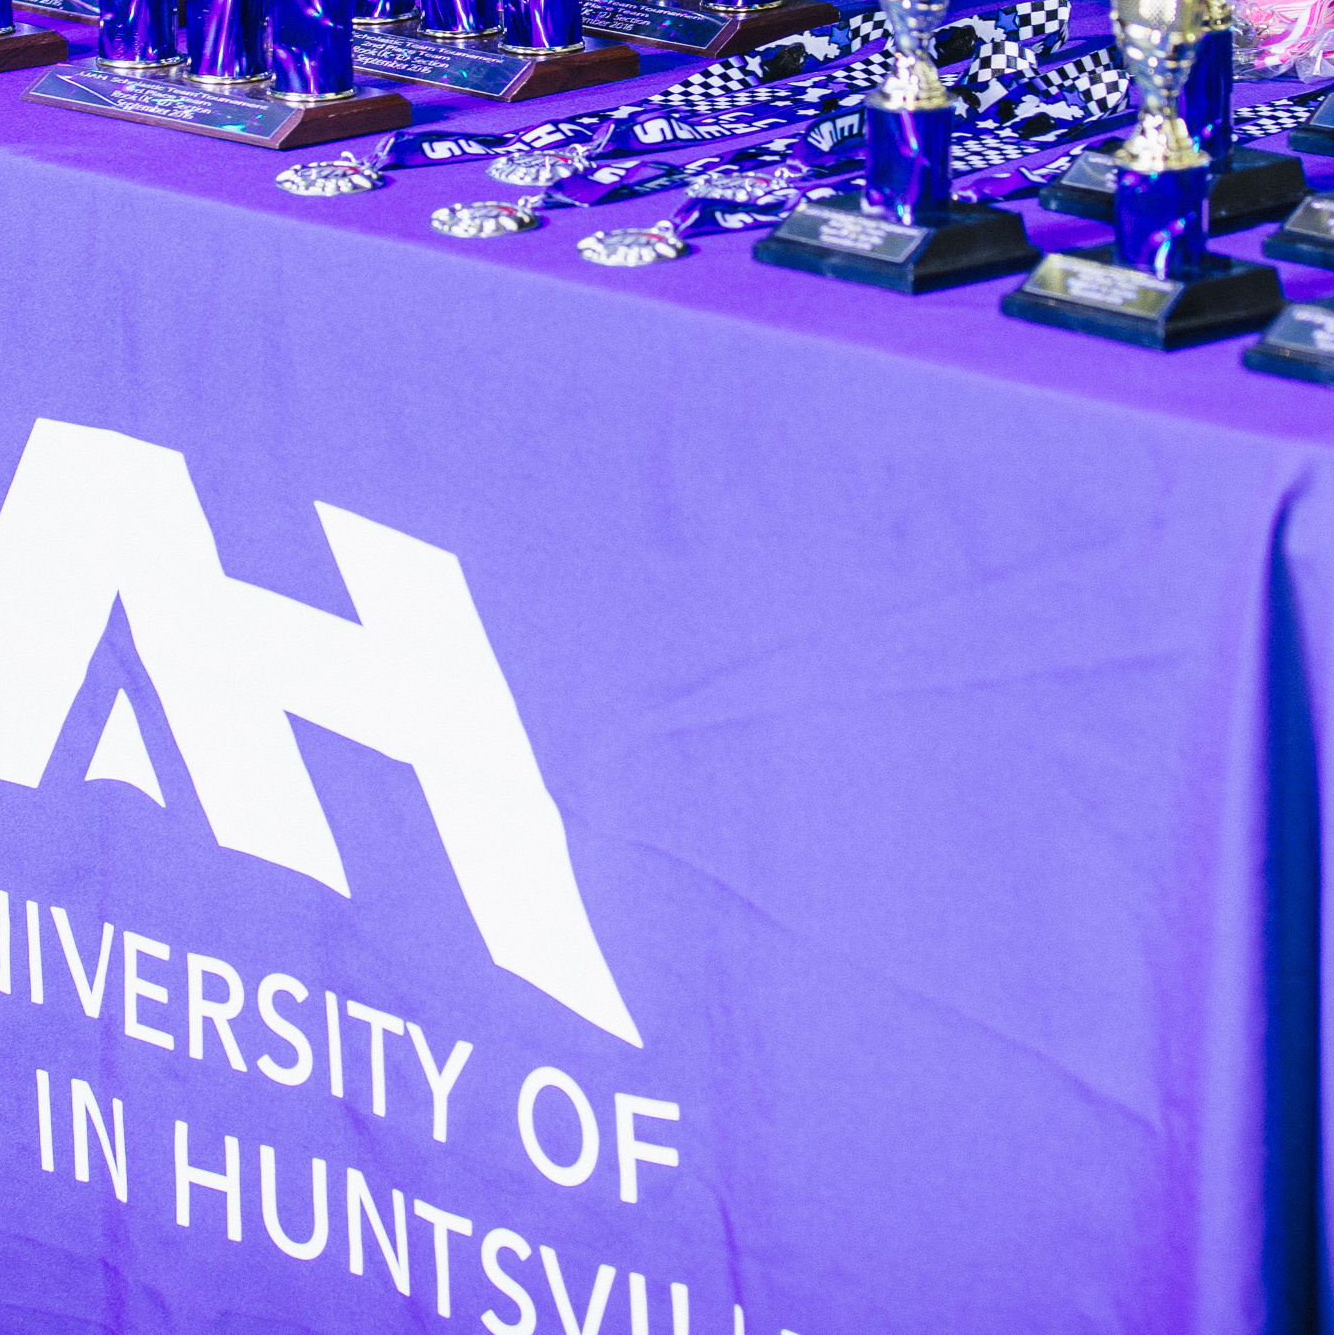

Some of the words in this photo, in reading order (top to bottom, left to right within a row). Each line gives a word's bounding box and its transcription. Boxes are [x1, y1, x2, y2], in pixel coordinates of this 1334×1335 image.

[613, 14, 651, 25] Section
[616, 8, 649, 17] Team
[609, 21, 634, 30] 2016
[406, 42, 436, 50] Team
[439, 48, 504, 62] Tournament
[418, 51, 451, 59] Team
[353, 54, 409, 71] September
[407, 63, 433, 73] 2016
[411, 57, 449, 68] Section
[110, 77, 165, 90] Scholastic
[166, 87, 198, 96] Team
[200, 93, 269, 109] Tournament
[111, 90, 138, 99] Rook
[173, 102, 212, 113] Section
[114, 99, 170, 115] September
[37, 1071, 128, 1202] IN
[518, 1065, 680, 1203] OF
